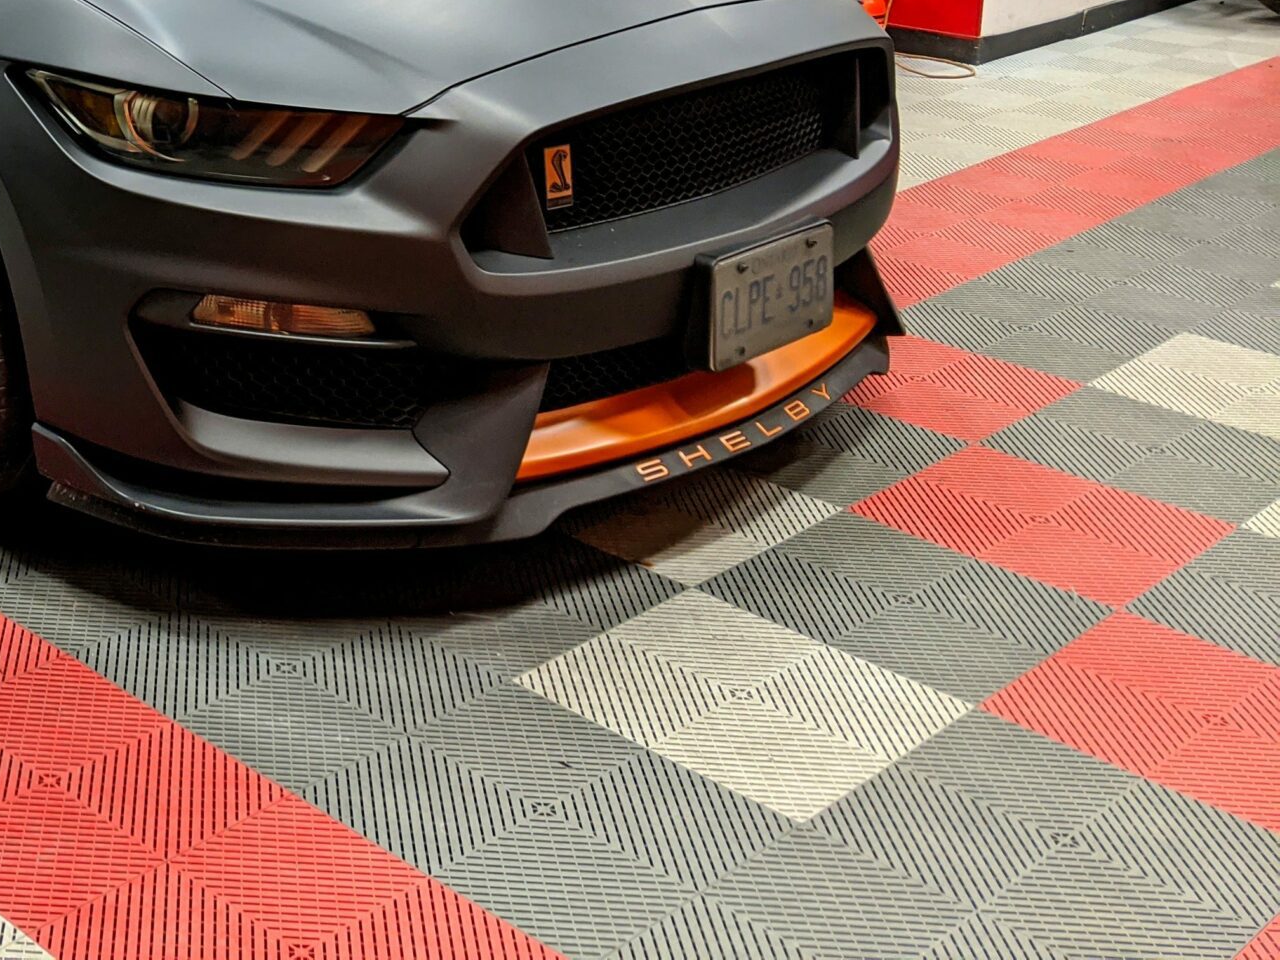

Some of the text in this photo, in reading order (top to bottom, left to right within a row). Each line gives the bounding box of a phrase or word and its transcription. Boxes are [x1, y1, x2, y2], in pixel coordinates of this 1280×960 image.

[721, 274, 775, 338] CLPE
[788, 255, 828, 312] 958
[636, 383, 831, 482] SHELBY
